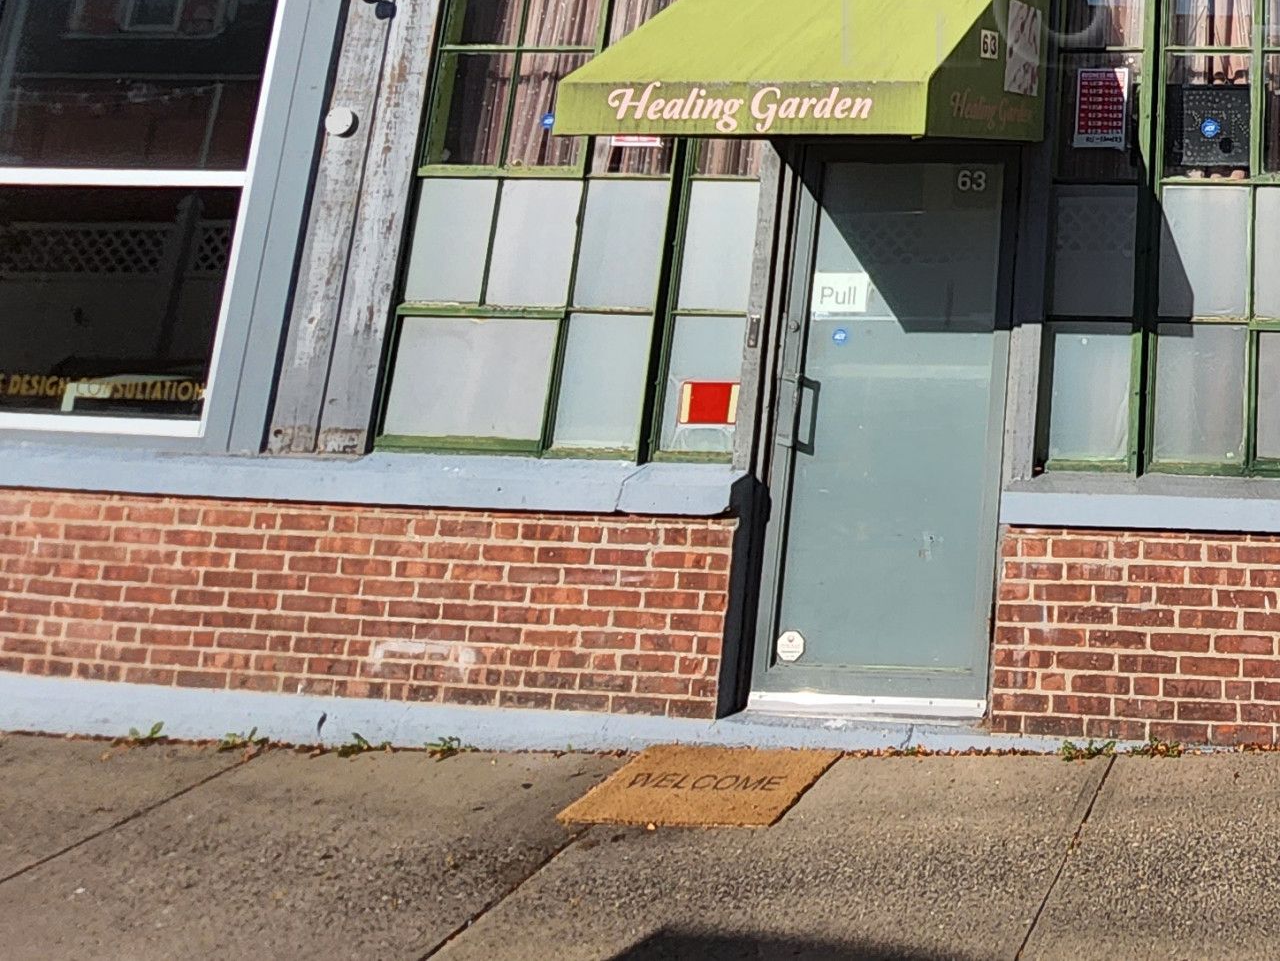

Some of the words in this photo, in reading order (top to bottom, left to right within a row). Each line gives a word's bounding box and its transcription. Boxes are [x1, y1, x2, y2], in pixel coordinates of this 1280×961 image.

[982, 34, 998, 56] 63
[607, 81, 744, 133] Healing
[751, 86, 873, 133] Garden
[957, 169, 986, 191] 63
[820, 286, 856, 305] Pull
[7, 374, 71, 397] DESIGN
[626, 772, 789, 792] WELCOME
